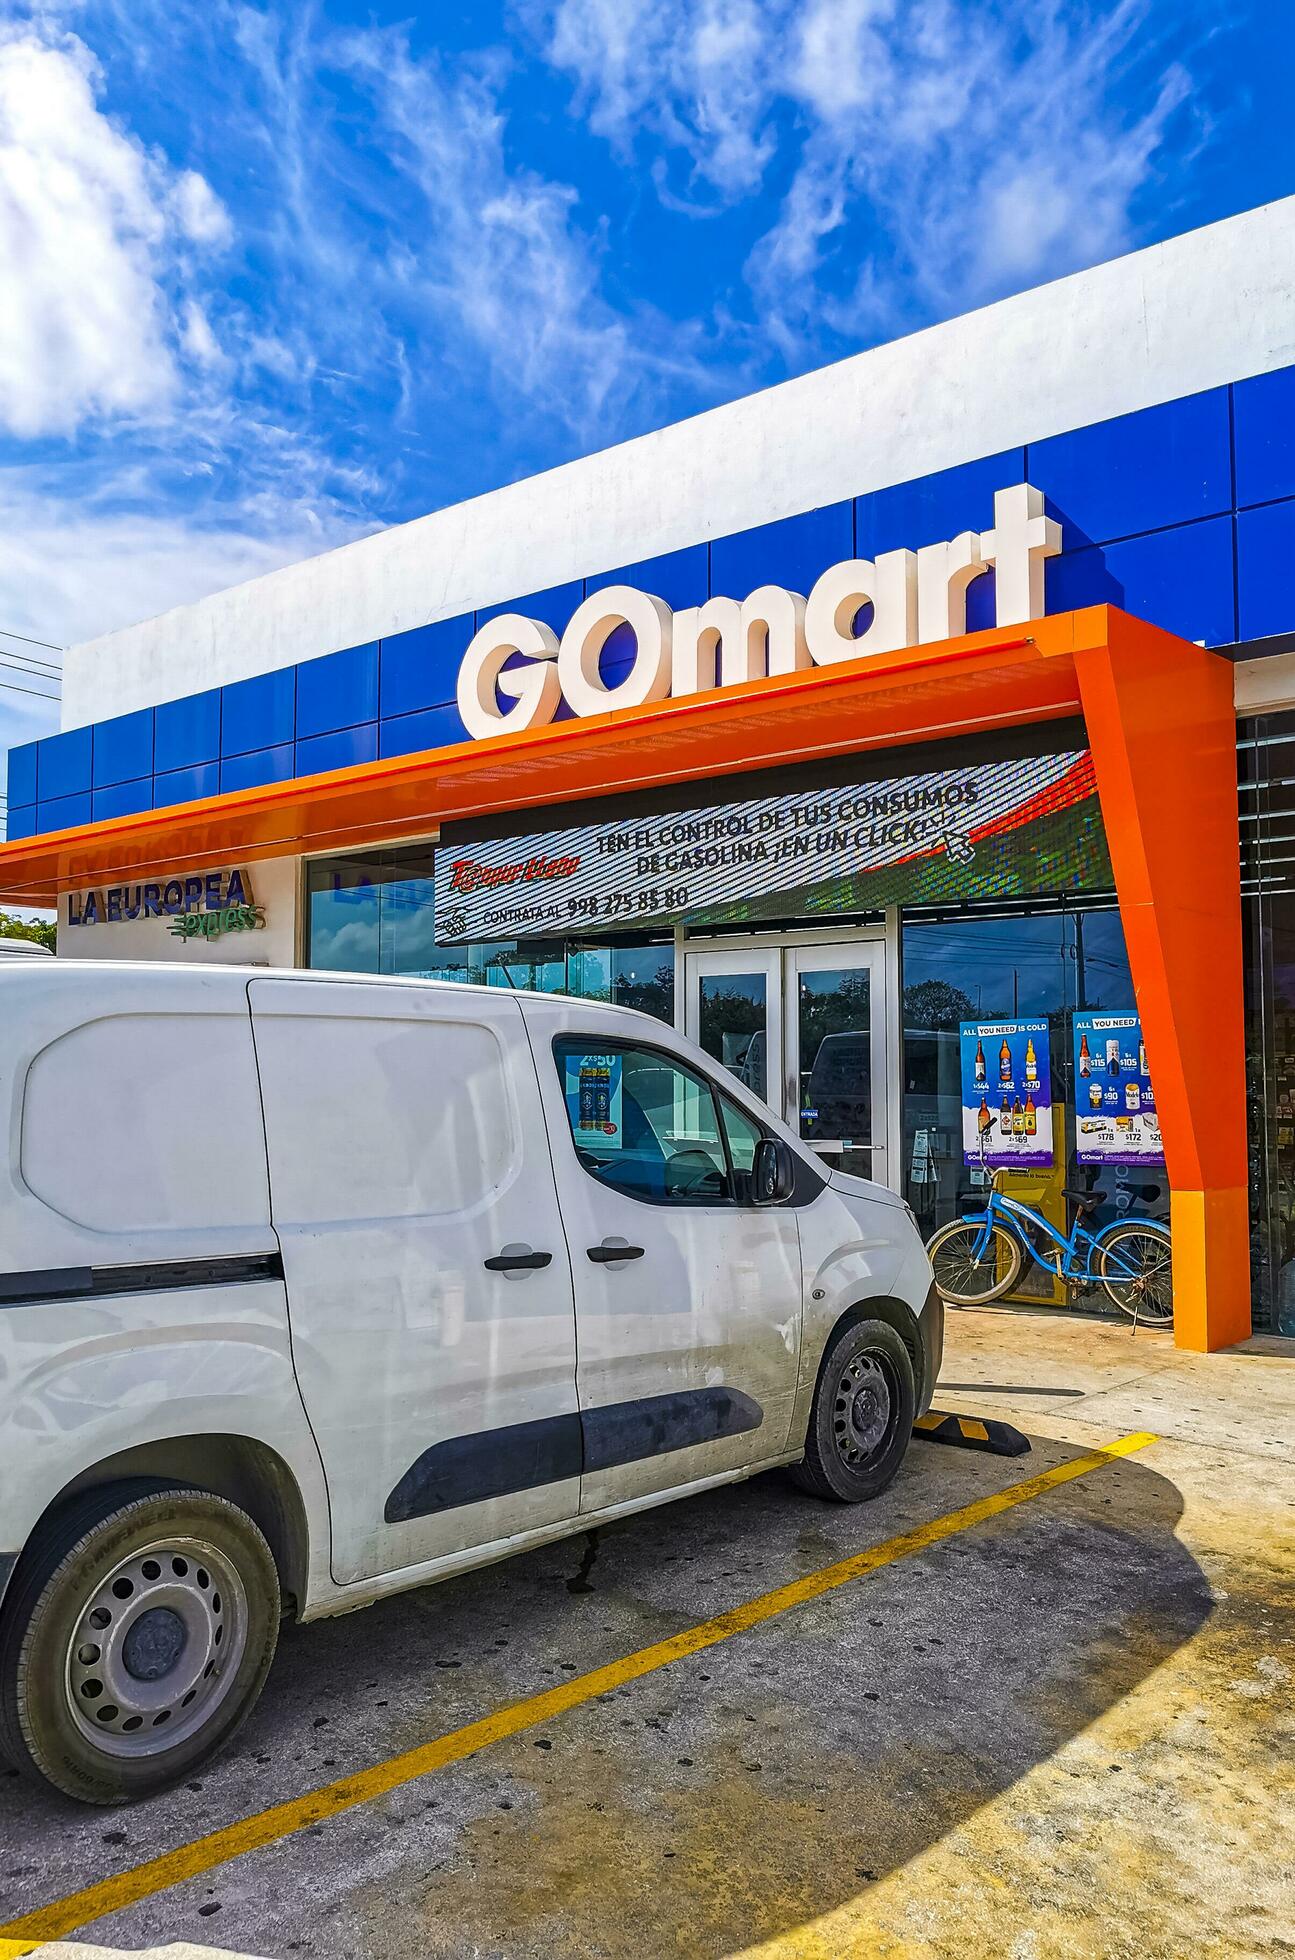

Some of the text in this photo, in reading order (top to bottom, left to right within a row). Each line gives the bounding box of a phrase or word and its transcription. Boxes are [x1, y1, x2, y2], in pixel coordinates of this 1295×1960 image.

[457, 482, 1062, 741] GOmart
[597, 782, 979, 854] TEN EL CONTROL DE TUS CONSUMOS
[637, 853, 661, 876] DE
[665, 840, 768, 872] GASOLINA
[815, 828, 848, 851] UN
[68, 869, 255, 926] LA EUROPEA
[483, 905, 544, 925] CONTRATA
[567, 896, 598, 917] 998
[602, 894, 633, 915] 275
[664, 886, 689, 907] 80
[184, 903, 265, 942] express
[1094, 1020, 1112, 1028] YOU
[1112, 1019, 1134, 1027] NEED
[979, 1026, 995, 1035] YOU
[996, 1025, 1015, 1034] NEED
[1090, 1058, 1106, 1067] $115
[1120, 1058, 1137, 1066] $105
[1104, 1091, 1118, 1100] $90
[1098, 1133, 1114, 1141] $178
[1125, 1133, 1141, 1141] $172
